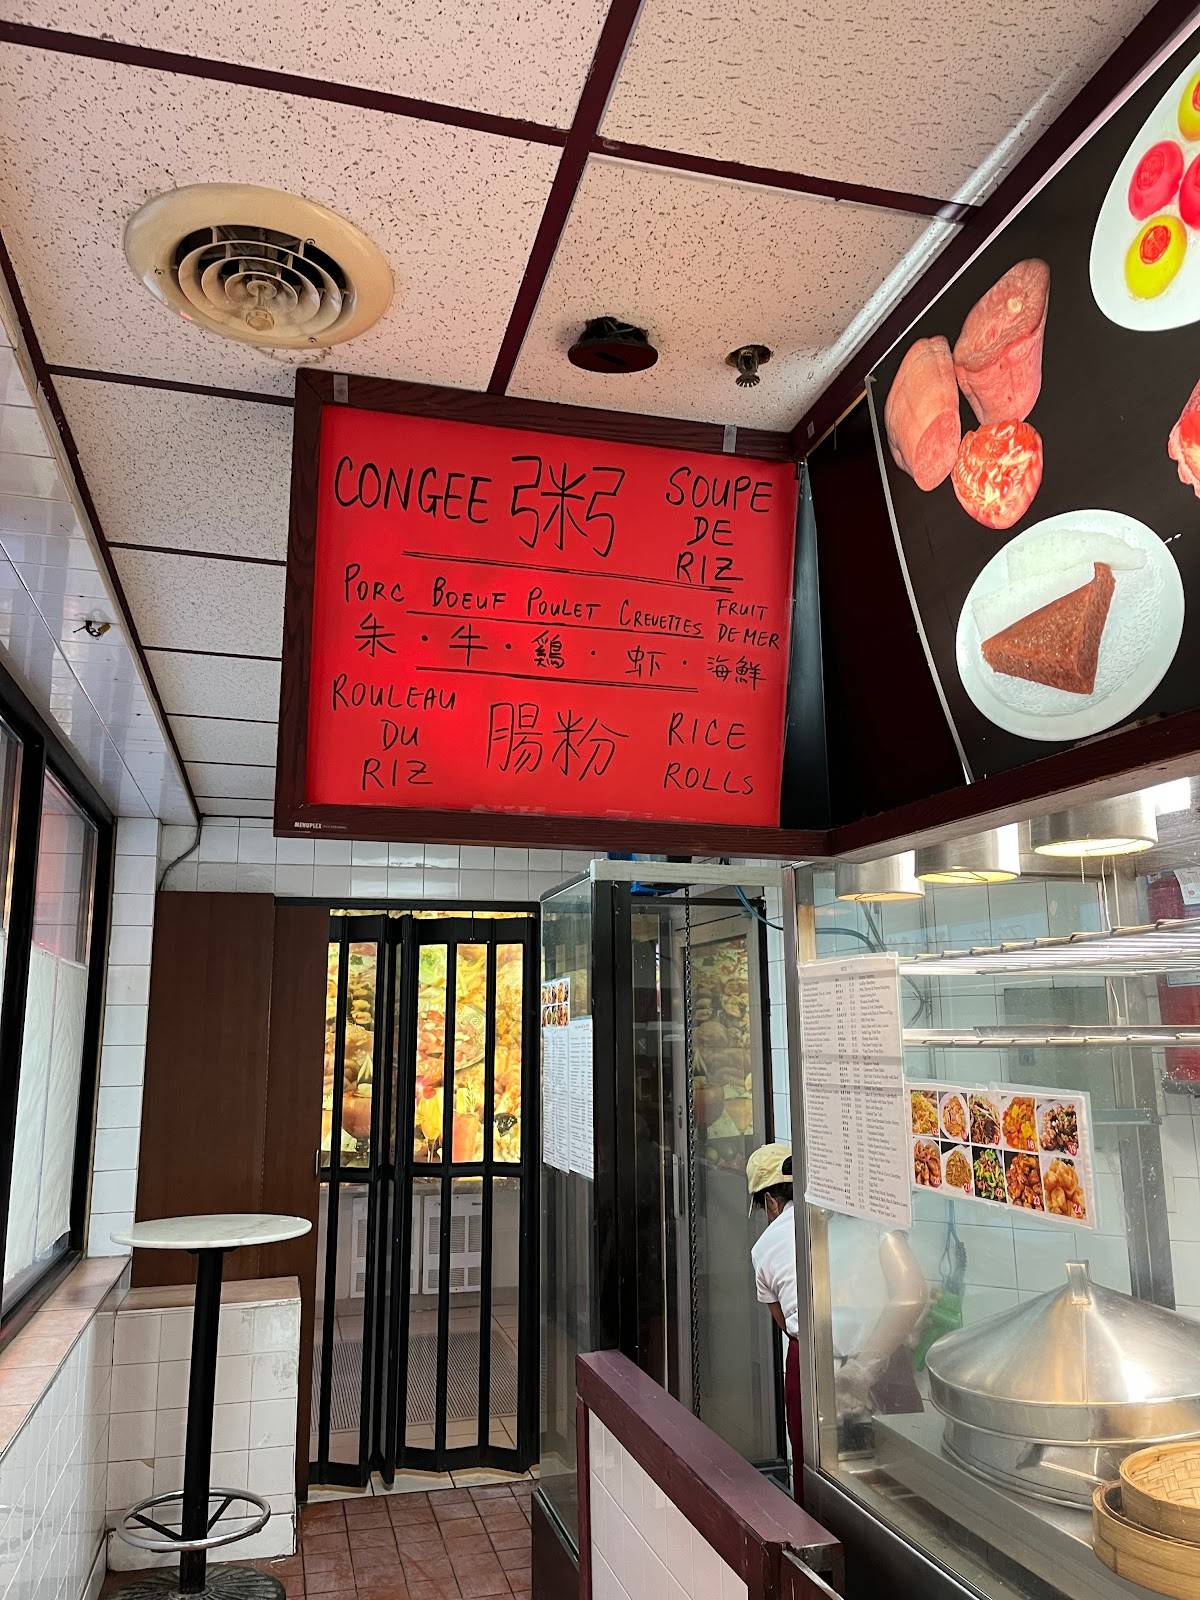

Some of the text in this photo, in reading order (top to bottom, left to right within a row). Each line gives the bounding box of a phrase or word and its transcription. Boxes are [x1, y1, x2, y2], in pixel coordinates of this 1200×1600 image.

[335, 456, 491, 523] CONGEE
[511, 455, 625, 557] 粥
[665, 465, 774, 513] SOUPE
[687, 516, 733, 547] DE
[676, 551, 744, 582] RIZ
[344, 563, 405, 603] PORC
[432, 577, 507, 611] BOEUF
[527, 586, 602, 621] POULET
[716, 599, 769, 623] FRUIT
[448, 623, 489, 667] 牛
[718, 624, 781, 651] DE MER
[332, 673, 456, 712] ROULEAU
[381, 720, 420, 751] DU
[487, 703, 629, 782] 腸粉
[668, 713, 747, 751] RICE
[362, 758, 433, 791] RIZ
[664, 763, 754, 795] ROLLS
